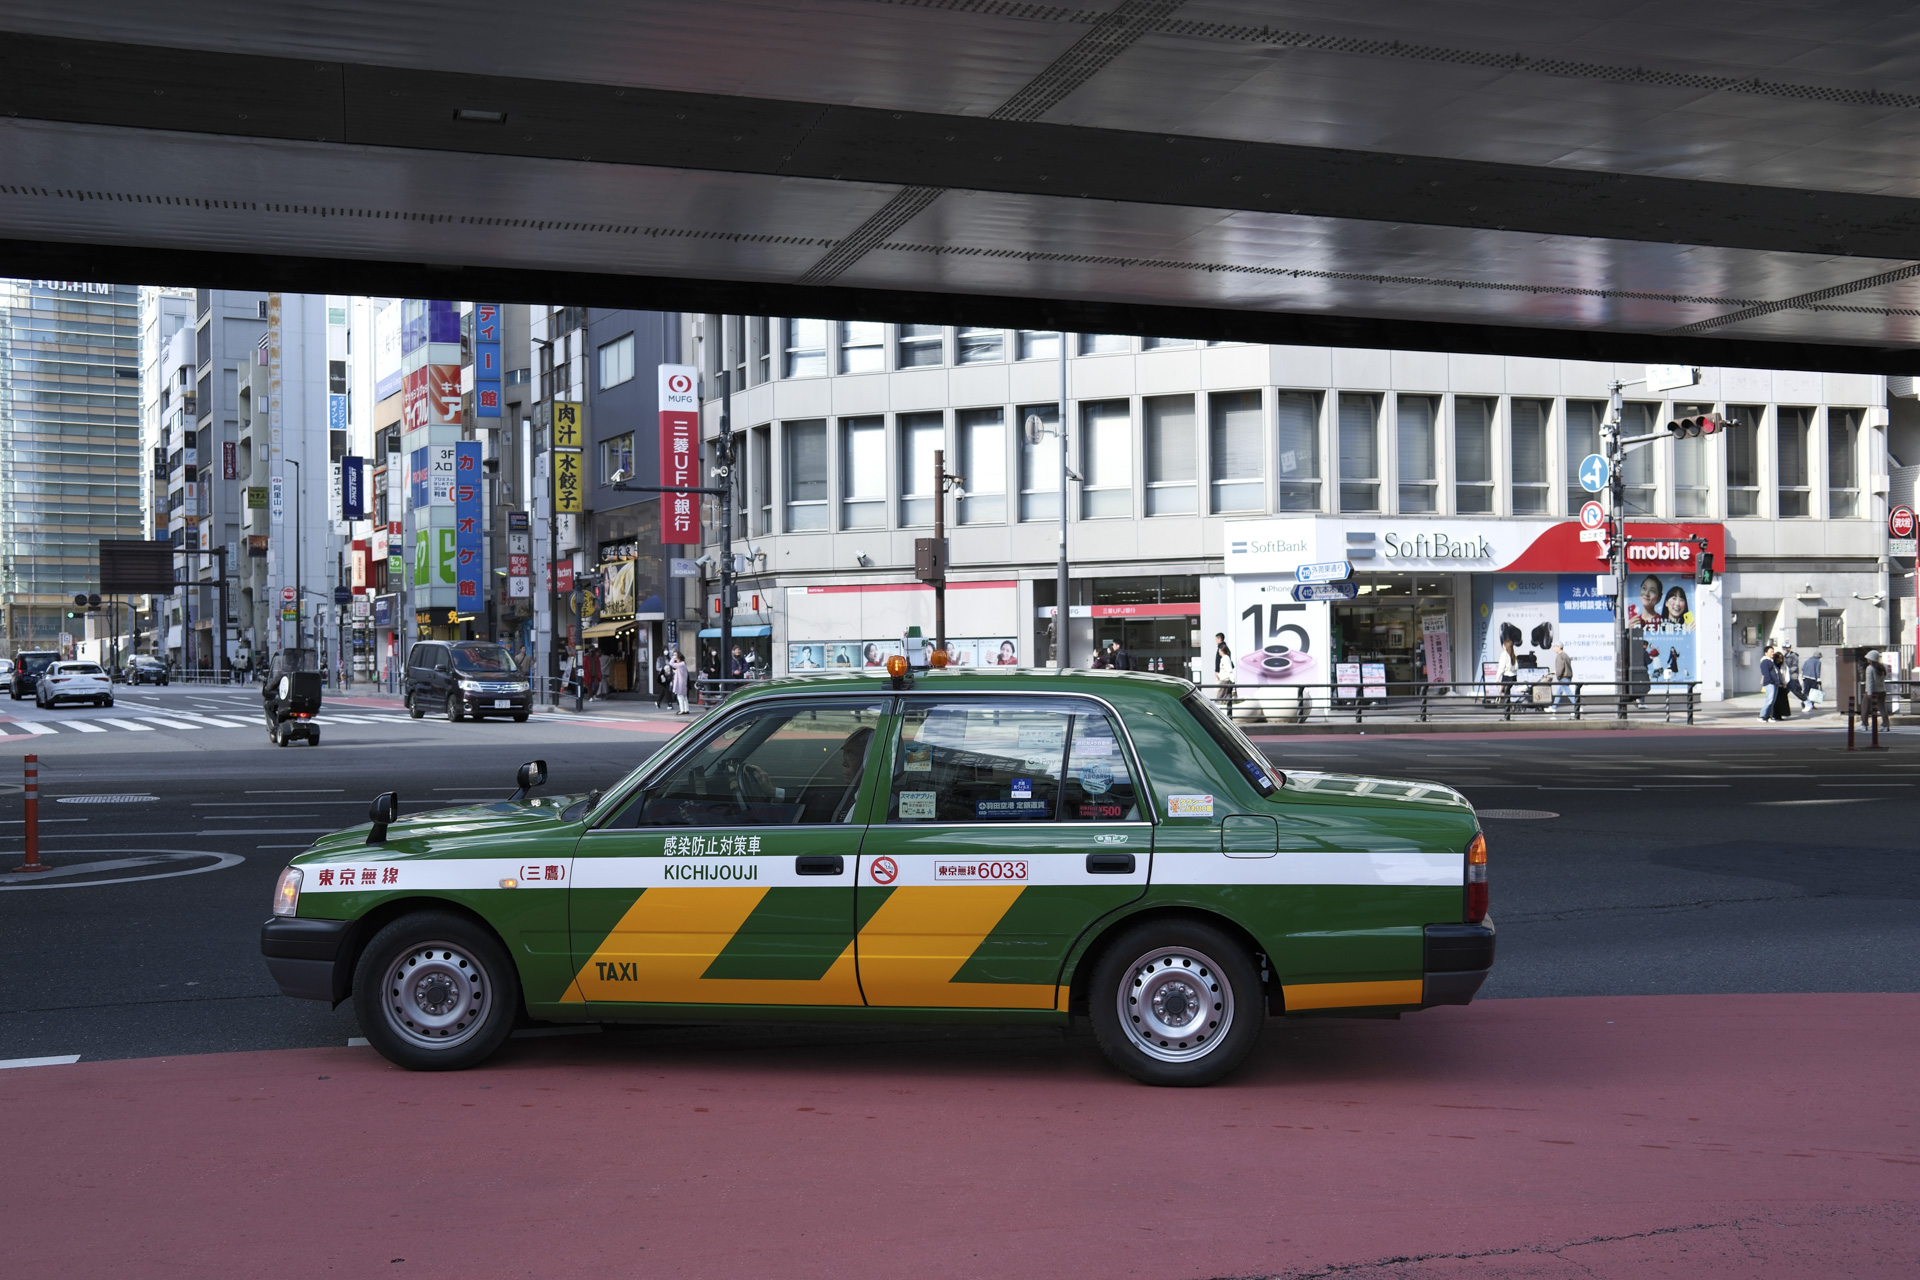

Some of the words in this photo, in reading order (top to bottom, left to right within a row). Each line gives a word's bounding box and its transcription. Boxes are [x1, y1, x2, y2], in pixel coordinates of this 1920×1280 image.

[669, 395, 692, 403] MUFG
[558, 404, 577, 444] 肉汁
[440, 449, 454, 459] 3F
[434, 462, 452, 471] 入口
[559, 454, 577, 510] 水餃子
[458, 454, 476, 597] カラオケ館
[1895, 517, 1911, 528] 消火栓
[1251, 540, 1308, 553] SoftBank
[1384, 532, 1491, 559] SoftBank
[1302, 589, 1313, 597] 412
[1242, 603, 1310, 653] 15
[1041, 757, 1056, 766] Pay
[986, 801, 1015, 809] 羽田空港
[1016, 801, 1045, 809] 定額運賃
[663, 835, 761, 856] 感染防止対策車
[318, 867, 399, 886] 東京無線
[664, 865, 758, 880] KICHIJOUJI
[938, 866, 976, 876] 東京無線
[978, 862, 1027, 879] 6033
[595, 962, 638, 981] TAXI
